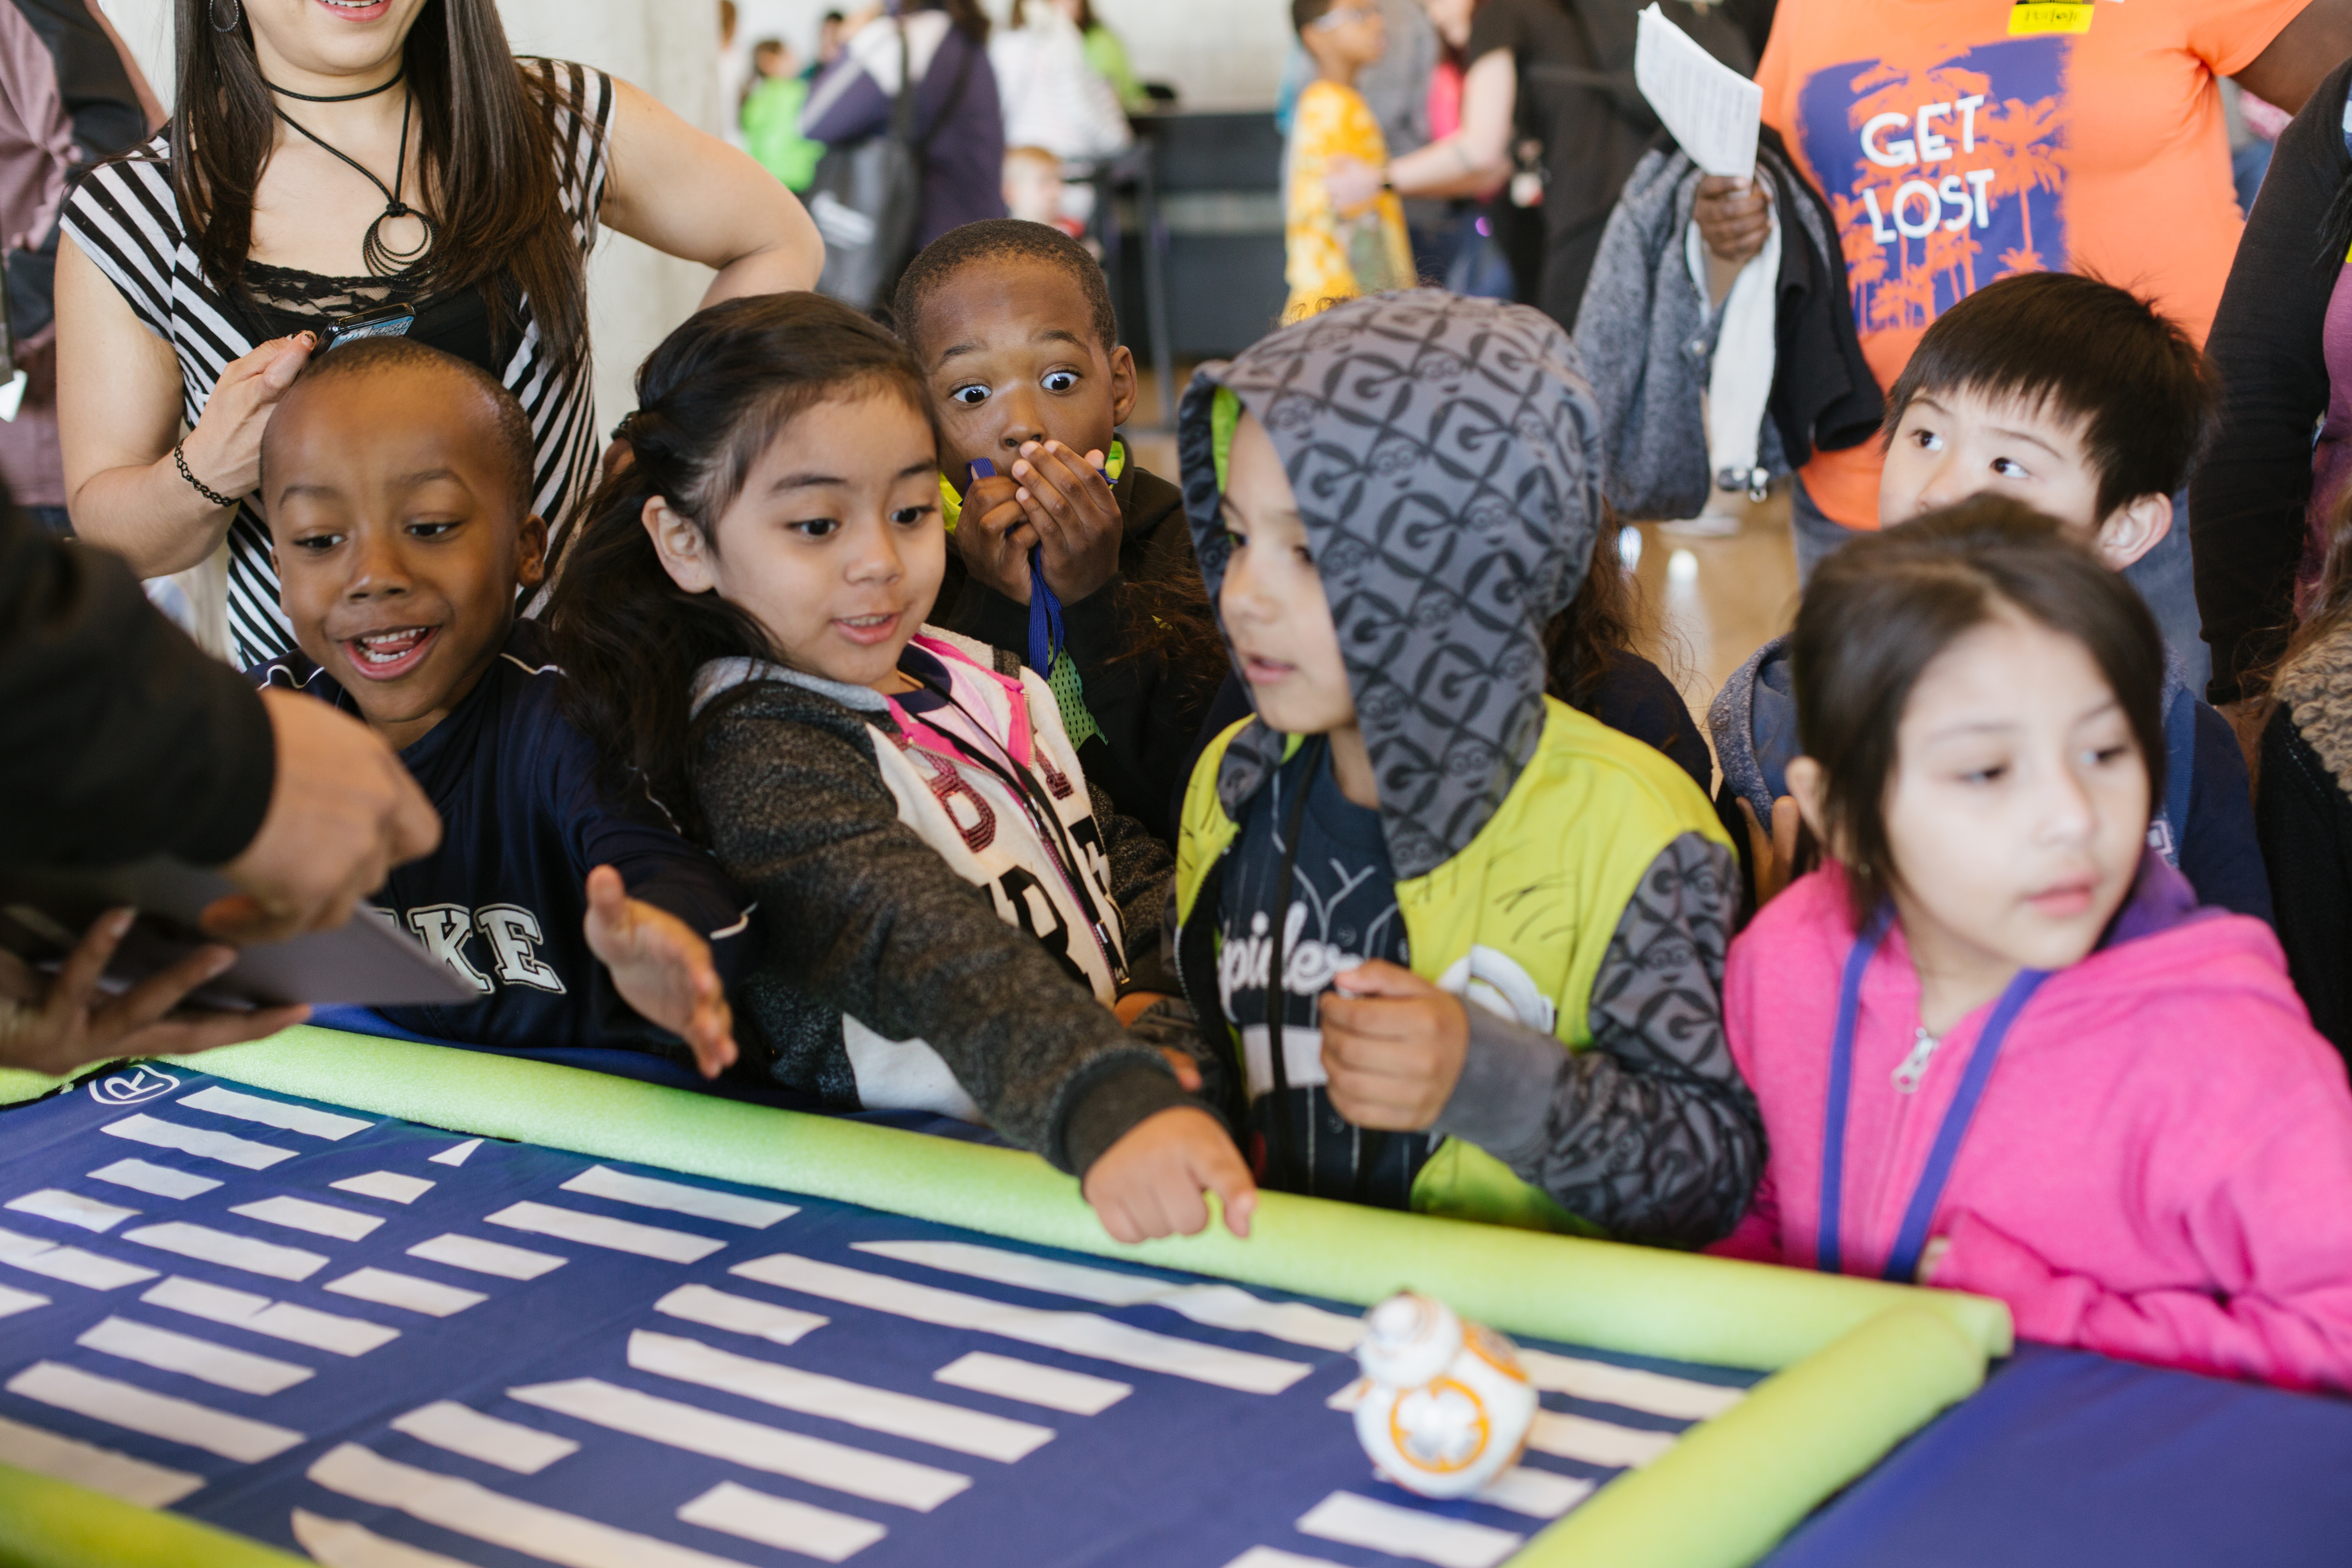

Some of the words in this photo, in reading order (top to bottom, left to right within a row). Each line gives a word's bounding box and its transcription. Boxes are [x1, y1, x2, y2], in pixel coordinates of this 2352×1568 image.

[1860, 94, 1984, 167] GET
[1862, 169, 1995, 244] LOST
[372, 903, 567, 994] KE
